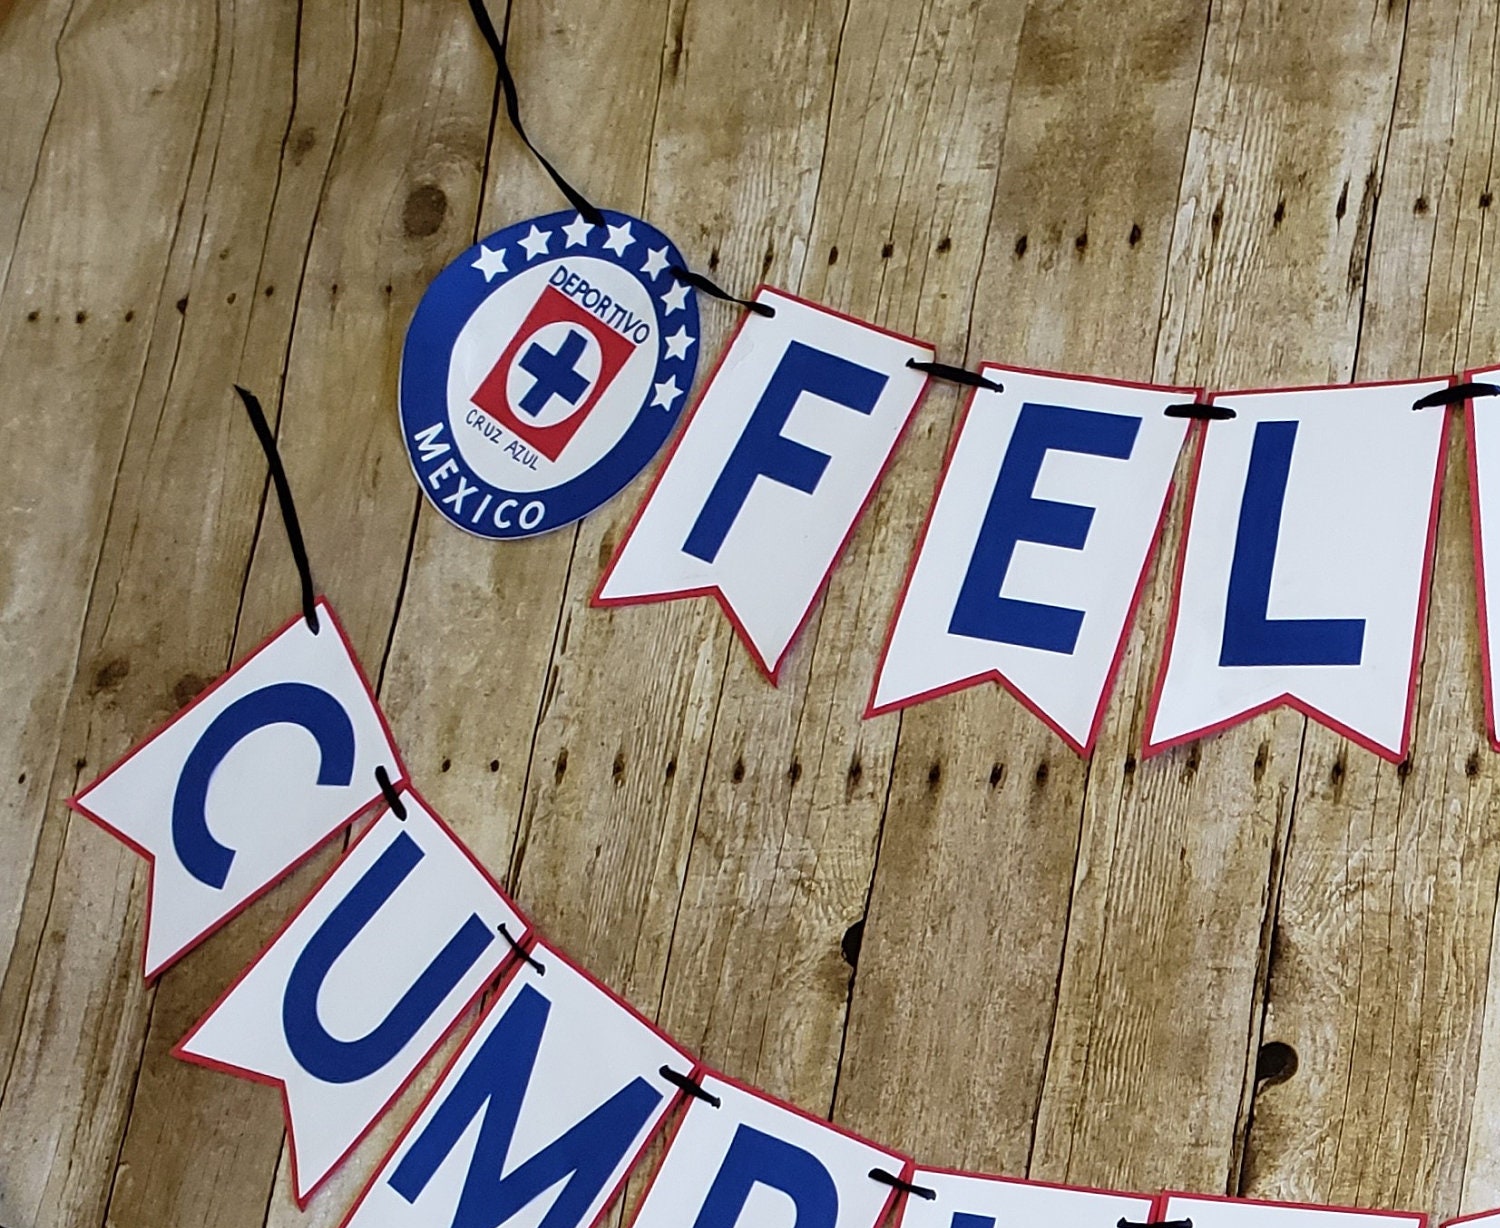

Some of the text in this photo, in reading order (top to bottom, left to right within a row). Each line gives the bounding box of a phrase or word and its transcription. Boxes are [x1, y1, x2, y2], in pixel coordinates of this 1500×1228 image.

[548, 265, 651, 345] DEPORTIVO
[414, 422, 545, 530] MEXICO
[465, 409, 541, 471] CRUZ AZUL
